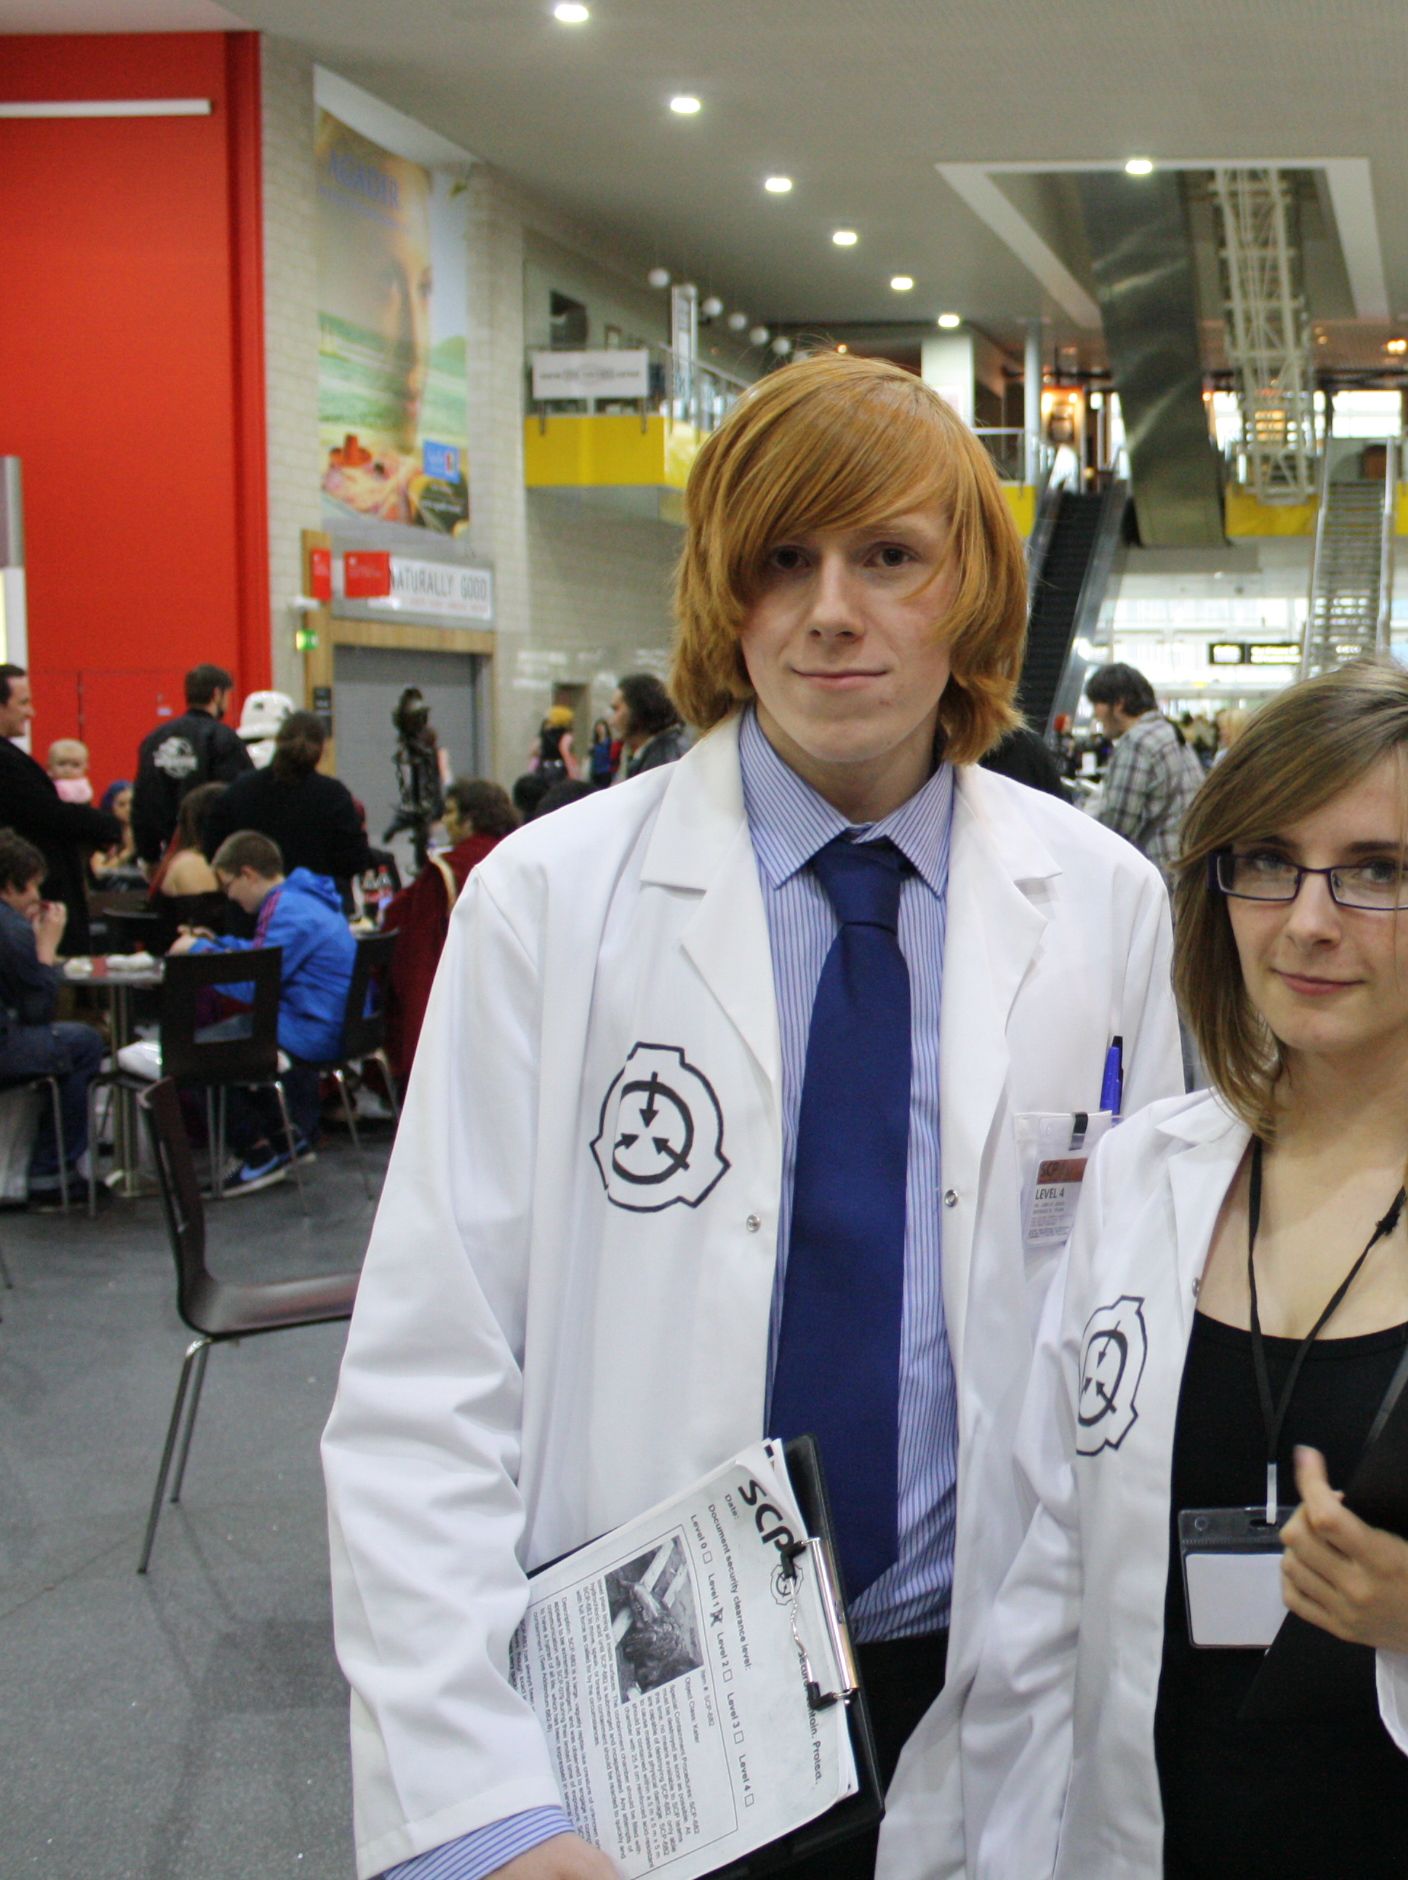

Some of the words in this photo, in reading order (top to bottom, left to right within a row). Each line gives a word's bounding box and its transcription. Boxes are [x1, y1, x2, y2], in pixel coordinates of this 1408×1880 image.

[460, 573, 488, 601] GOOD
[1040, 1160, 1060, 1177] SCP
[1035, 1187, 1058, 1201] LEVEL
[1058, 1187, 1065, 1198] 4
[724, 1493, 740, 1520] Date:
[738, 1479, 794, 1552] SCP
[690, 1514, 705, 1543] Level
[707, 1504, 731, 1558] Document
[725, 1555, 739, 1593] security
[733, 1596, 746, 1642] clearance
[742, 1643, 753, 1671] level:
[708, 1573, 719, 1602] Level
[716, 1632, 729, 1659] Level
[721, 1660, 730, 1668] 2
[704, 1694, 714, 1726] SCP-682
[726, 1692, 739, 1720] Level
[732, 1720, 740, 1729] 3
[738, 1753, 750, 1784] Level
[743, 1784, 751, 1792] 4
